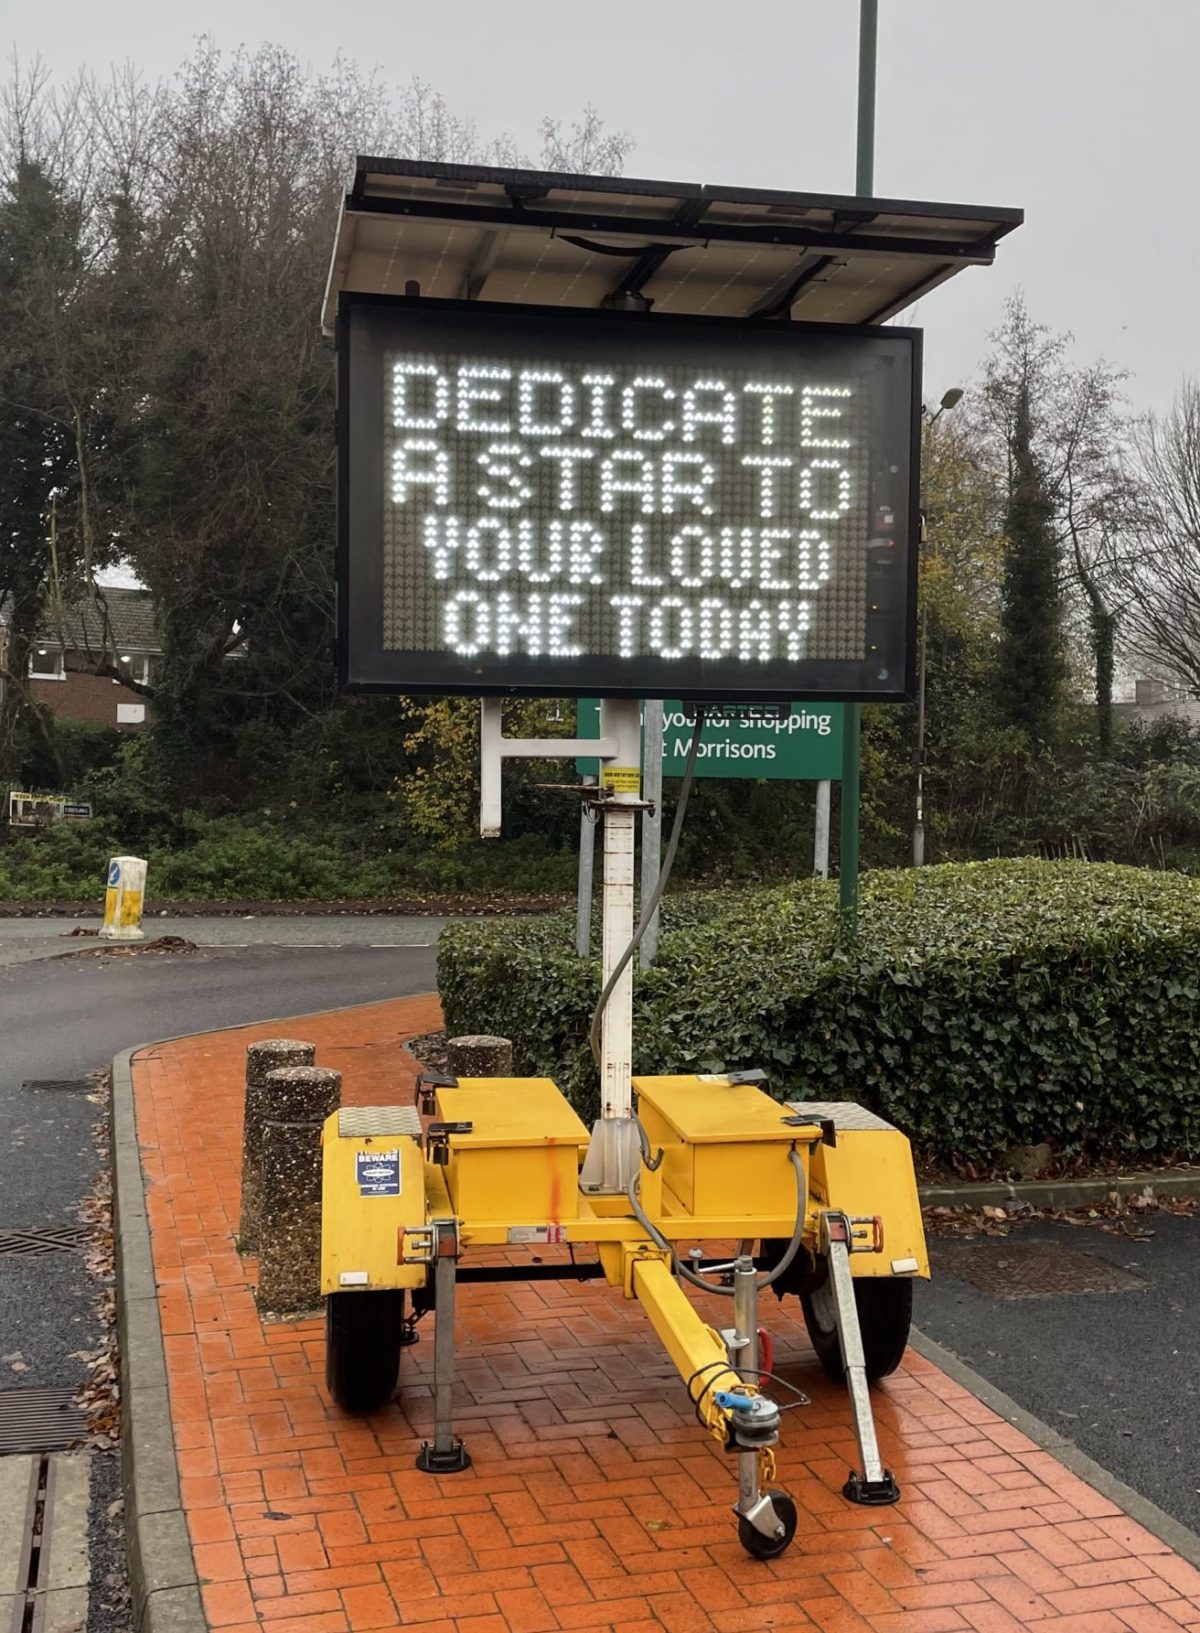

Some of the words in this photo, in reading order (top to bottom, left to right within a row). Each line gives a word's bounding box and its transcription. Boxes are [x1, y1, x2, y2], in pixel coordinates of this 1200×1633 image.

[392, 362, 852, 449] DEDICATE
[392, 438, 450, 506] A
[476, 443, 715, 516] STAR
[741, 455, 851, 520] TO
[423, 514, 605, 585] YOUR
[630, 522, 834, 591] LOVED
[443, 591, 586, 657] ONE
[609, 596, 812, 662] TODAY
[662, 712, 696, 732] you
[739, 709, 832, 735] shopping
[673, 738, 776, 759] Morrisons
[358, 1153, 398, 1162] BEWARE
